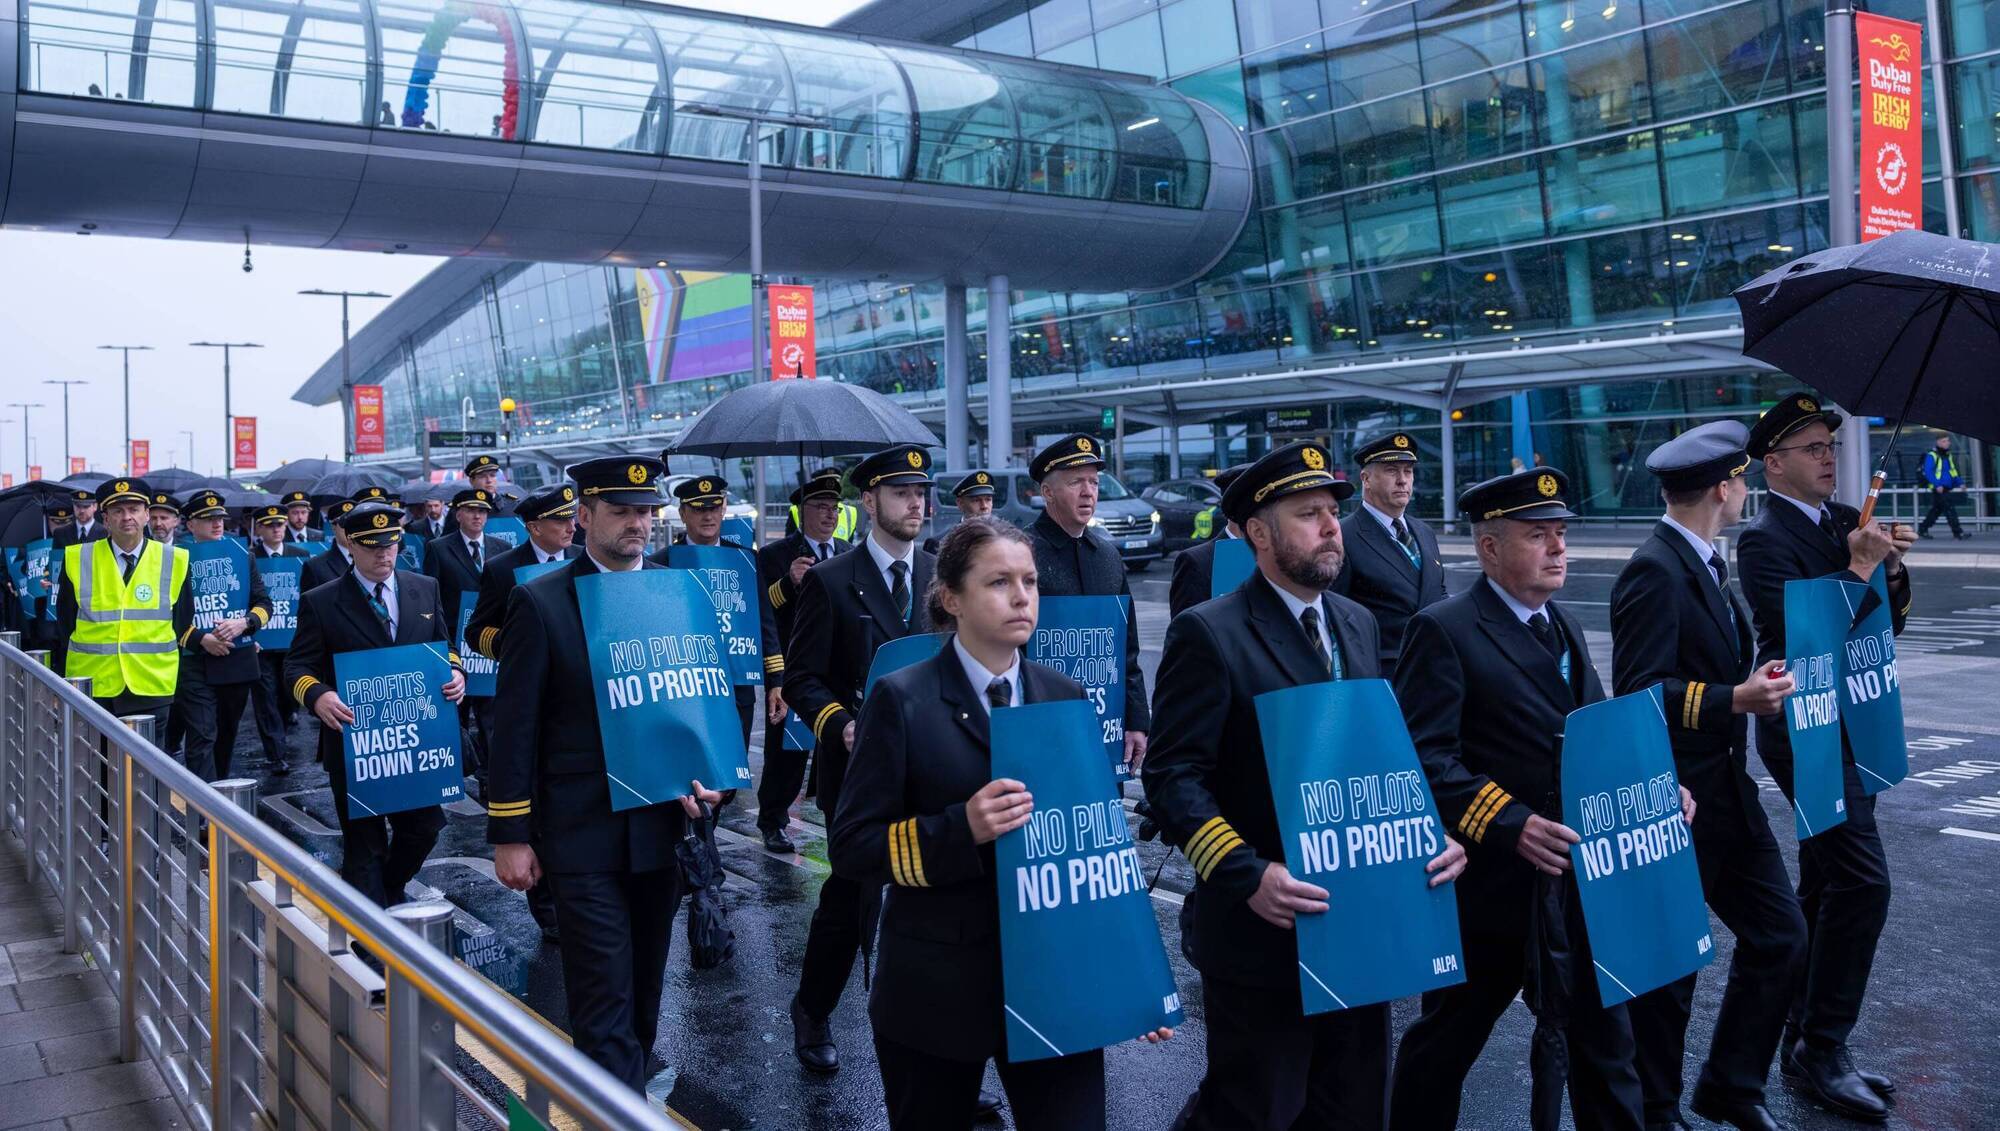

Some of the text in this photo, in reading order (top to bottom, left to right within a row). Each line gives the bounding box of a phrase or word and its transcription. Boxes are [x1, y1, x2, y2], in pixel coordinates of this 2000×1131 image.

[1869, 58, 1911, 84] Dubai
[1871, 76, 1912, 95] Duty Free
[1872, 92, 1910, 117] IRISH
[1873, 110, 1910, 131] DERBY
[777, 305, 807, 316] Dubai
[779, 320, 807, 330] IRISH
[190, 557, 233, 578] OFITS
[700, 567, 740, 591] FITS
[200, 573, 240, 594] 400%
[193, 592, 229, 613] AGES
[272, 600, 290, 615] GES
[713, 590, 747, 612] 00%
[192, 610, 224, 629] OWN
[287, 616, 298, 628] 25
[609, 634, 718, 674] NO PILOTS
[728, 637, 757, 655] 25%
[1036, 627, 1115, 657] PROFITS
[1846, 635, 1881, 671] NO
[1071, 656, 1119, 686] 400%
[345, 671, 426, 705] PROFITS
[607, 667, 729, 710] NO PROFITS
[1846, 670, 1881, 704] NO
[349, 695, 437, 730] UP 400%
[1792, 695, 1808, 731] NO
[350, 723, 420, 756] WAGES
[1103, 718, 1123, 744] 25%
[354, 747, 455, 782] DOWN 25%
[441, 785, 460, 797] IALPA
[1300, 770, 1425, 826] NO PILOTS
[1580, 771, 1678, 836] NO PILOTS
[1023, 798, 1135, 860] NO PILOT
[1299, 815, 1437, 875] NO PROFITS
[1580, 810, 1689, 881] NO PROFITS
[1016, 847, 1150, 913] NO PROFIT
[1432, 954, 1458, 975] IALPA
